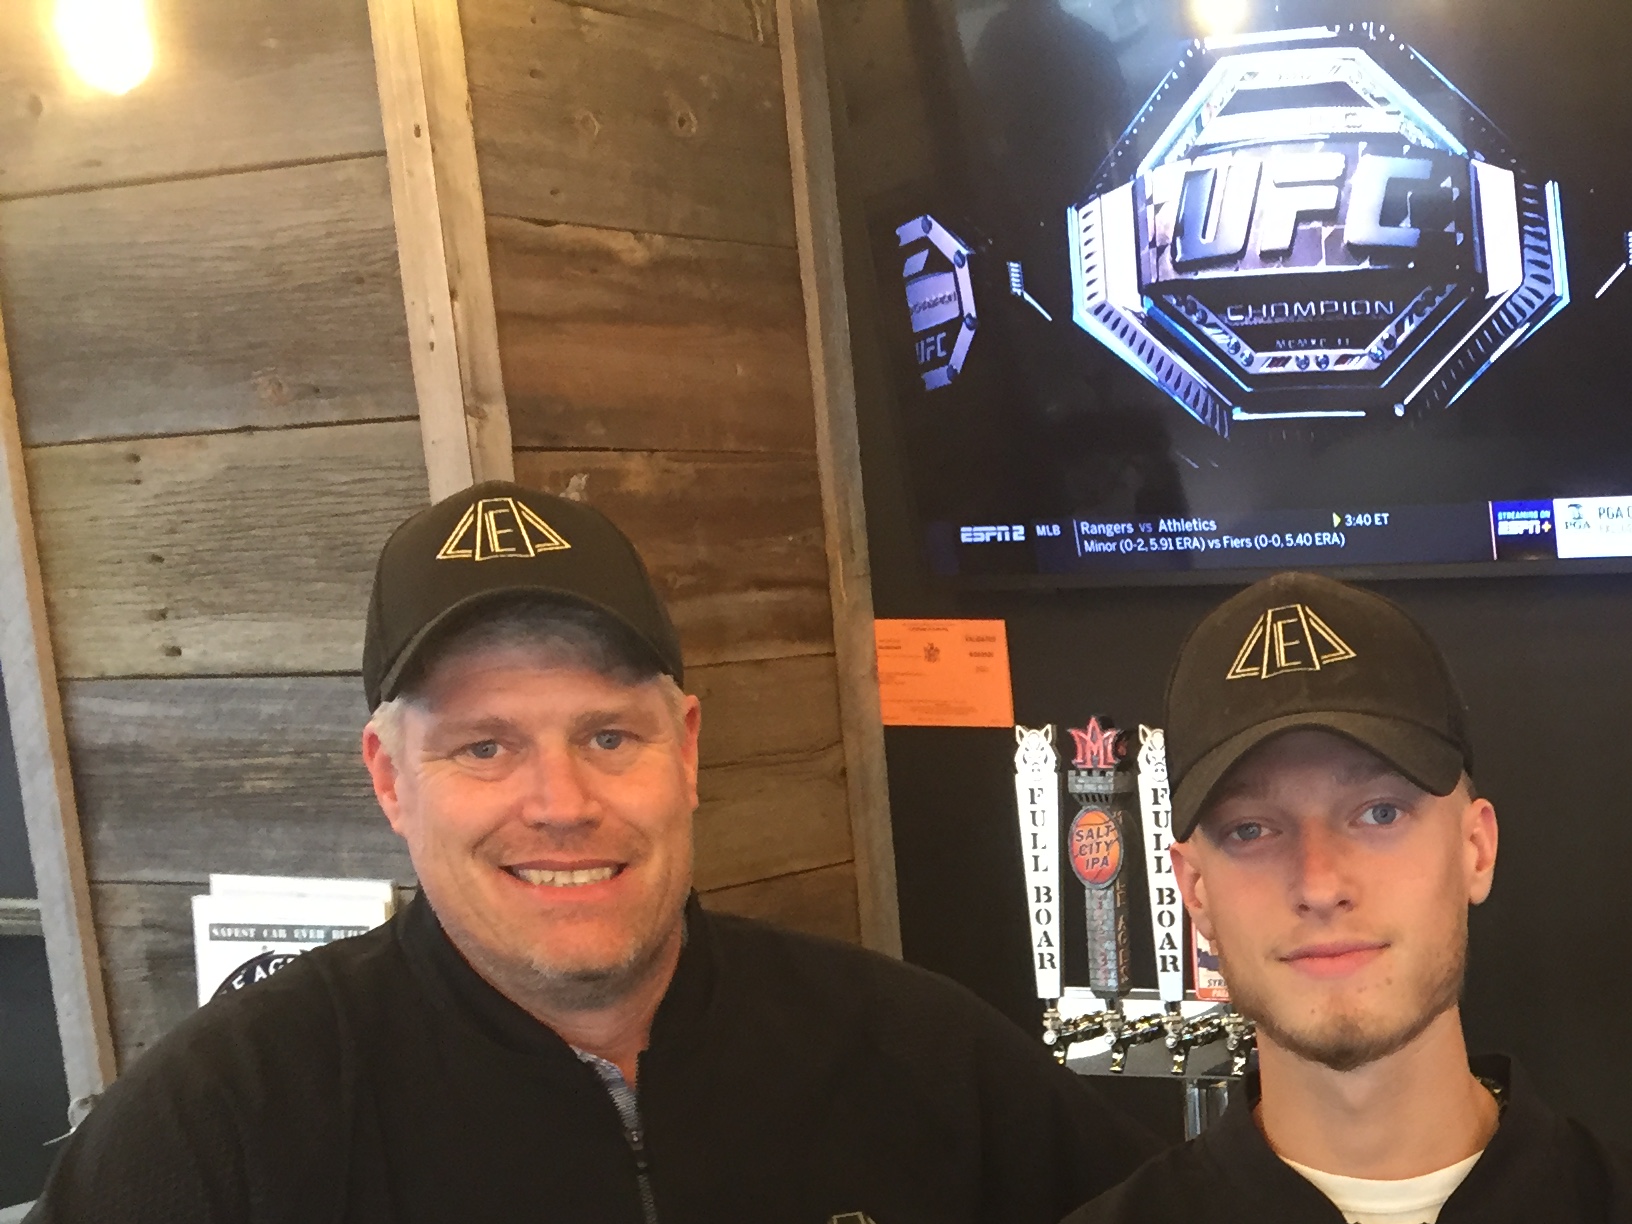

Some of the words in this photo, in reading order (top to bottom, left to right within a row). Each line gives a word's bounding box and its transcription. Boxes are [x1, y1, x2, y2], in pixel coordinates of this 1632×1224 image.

[1173, 150, 1433, 266] UFC
[1227, 300, 1395, 321] CHAMPION
[1080, 521, 1134, 536] Rangers
[1139, 523, 1153, 533] vs
[1158, 517, 1217, 533] Athletics
[1344, 513, 1371, 527] 3:40
[1373, 512, 1390, 526] ET
[1598, 506, 1624, 520] PGA
[1036, 524, 1061, 537] MLB
[1084, 538, 1117, 553] Minor
[1120, 537, 1148, 554] (0-2,
[1149, 537, 1174, 551] 5.91
[1175, 535, 1205, 552] ERA)
[1207, 539, 1221, 549] vs
[1223, 534, 1252, 549] Fiers
[1254, 533, 1283, 551] (0-0,
[1285, 533, 1313, 547] 5.40
[1315, 531, 1346, 548] ERA)
[1028, 786, 1049, 873] FULL
[1075, 826, 1113, 842] SALT
[1078, 840, 1113, 857] CITY
[1085, 856, 1110, 871] IPA
[1033, 886, 1058, 970] BOAR
[1157, 886, 1181, 973] BOAR
